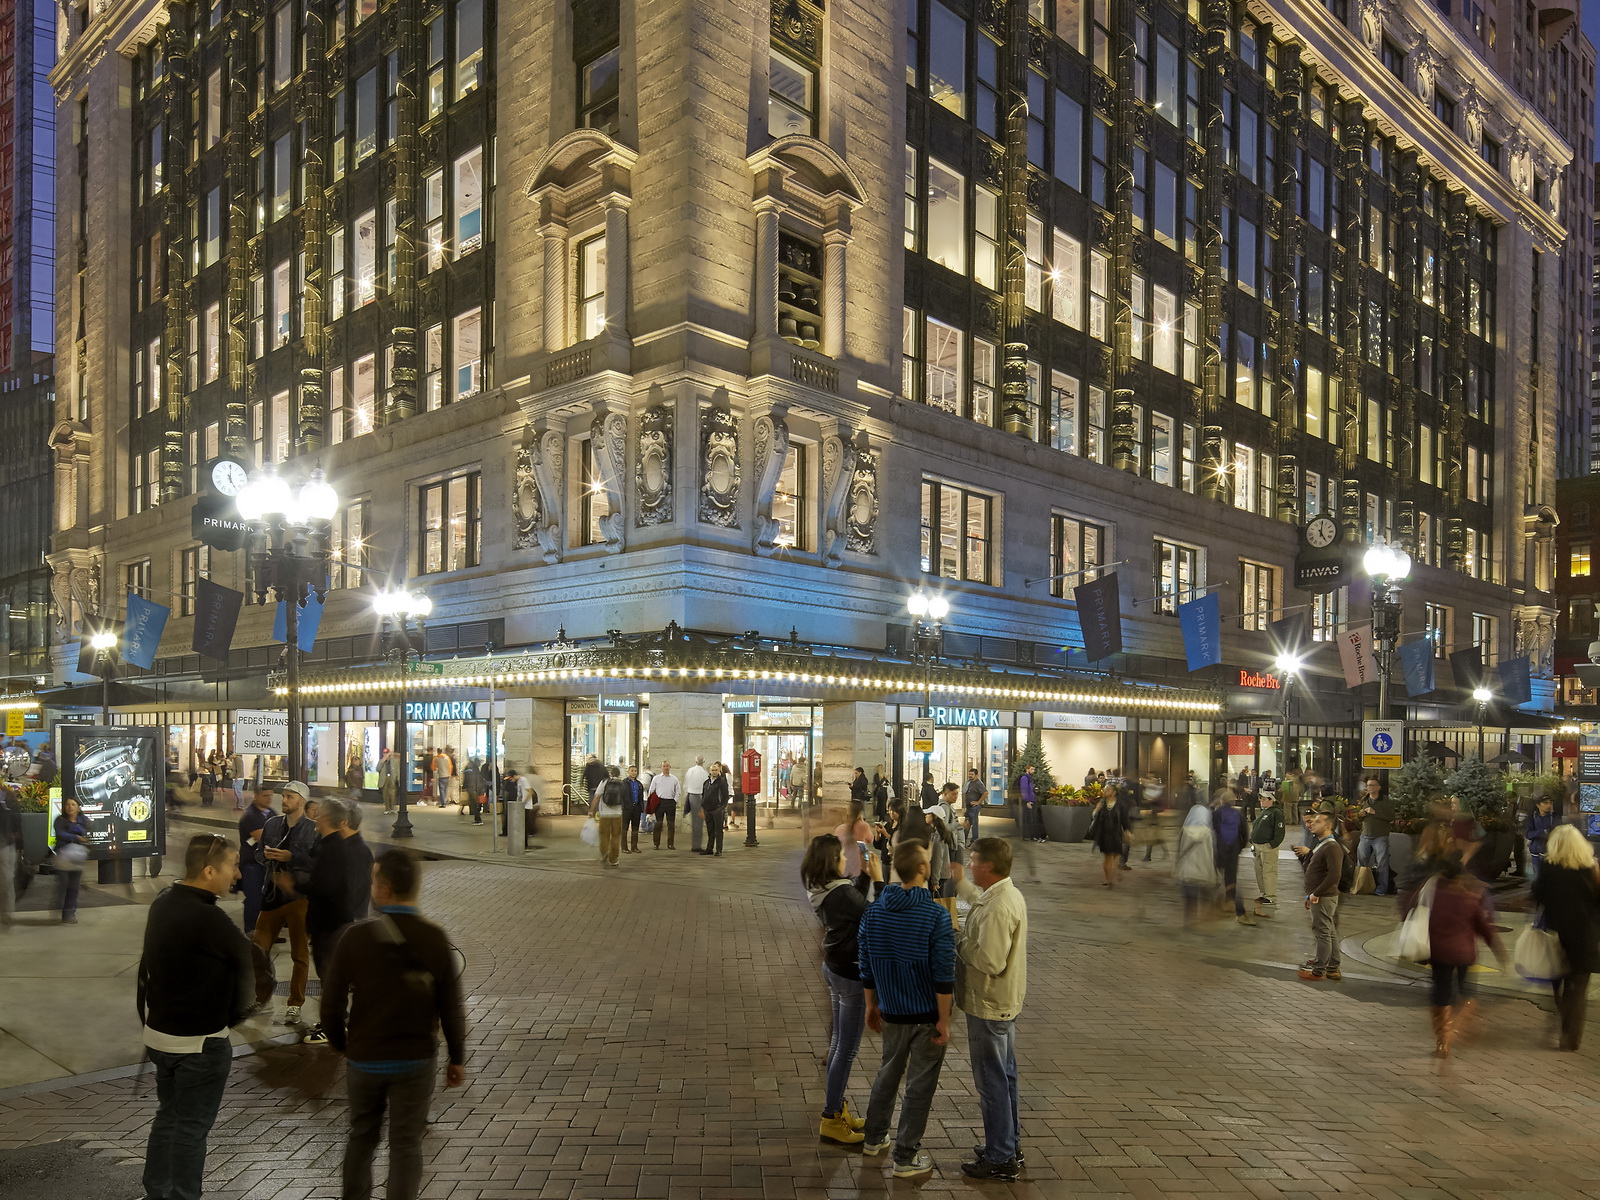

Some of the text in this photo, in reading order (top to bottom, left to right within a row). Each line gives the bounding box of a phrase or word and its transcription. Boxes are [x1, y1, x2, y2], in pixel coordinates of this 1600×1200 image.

[1301, 565, 1339, 578] HAVAS
[203, 593, 223, 647] PRIMARK
[1093, 588, 1111, 649] PRIMARK
[129, 607, 151, 657] PRIMARK
[1195, 606, 1210, 660] PRIMARK
[1354, 642, 1363, 665] Roche
[415, 663, 434, 673] SUMMER
[1240, 670, 1281, 689] Roche Bro
[570, 702, 598, 710] DOWNTOWN
[604, 699, 635, 708] PRIMARK
[727, 701, 755, 709] PRIMARK
[405, 701, 472, 720] PRIMARK
[929, 706, 999, 727] PRIMARK
[238, 716, 288, 727] PEDESTRIANS
[1089, 716, 1113, 724] CROSSING
[256, 729, 271, 737] USE
[244, 740, 281, 749] SIDEWALK
